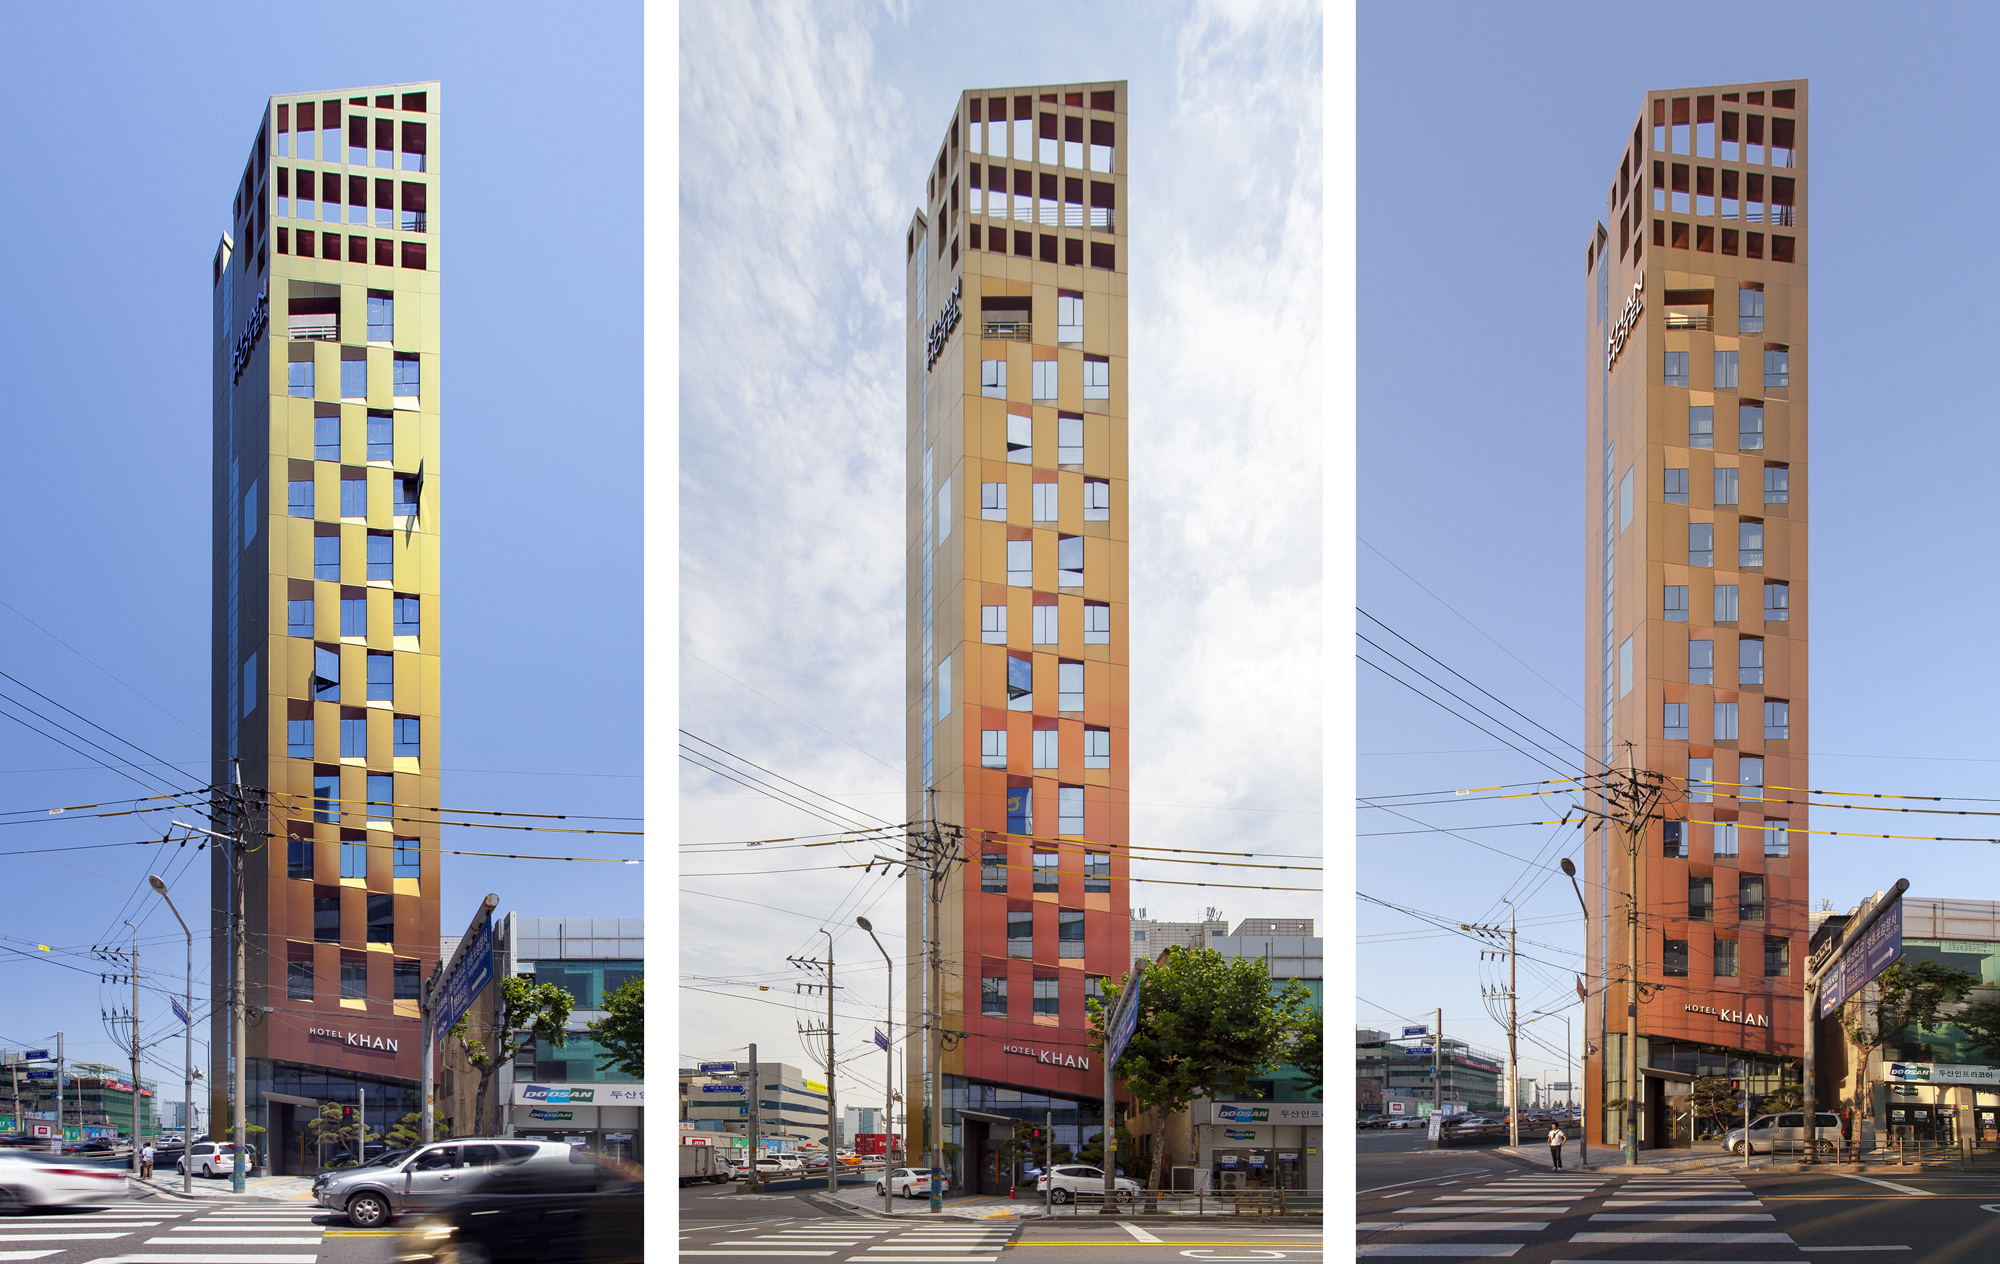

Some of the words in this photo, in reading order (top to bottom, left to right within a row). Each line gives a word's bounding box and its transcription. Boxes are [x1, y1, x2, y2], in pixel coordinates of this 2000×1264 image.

[233, 307, 267, 384] HOTEL
[927, 301, 960, 371] HOTEL
[1608, 297, 1644, 371] HOTEL
[1685, 1004, 1716, 1014] HOTEL
[1721, 1008, 1769, 1027] KHAN
[309, 1027, 343, 1038] HOTEL
[347, 1032, 398, 1052] KHAN
[1003, 1044, 1036, 1056] HOTEL
[1040, 1049, 1089, 1070] KHAN
[1890, 1068, 1930, 1076] DOOSAN
[1939, 1069, 1993, 1079] 두산인프라코어
[523, 1089, 594, 1100] DOOSAN
[1219, 1109, 1269, 1118] DOOSAN
[1280, 1110, 1323, 1119] 두산인프
